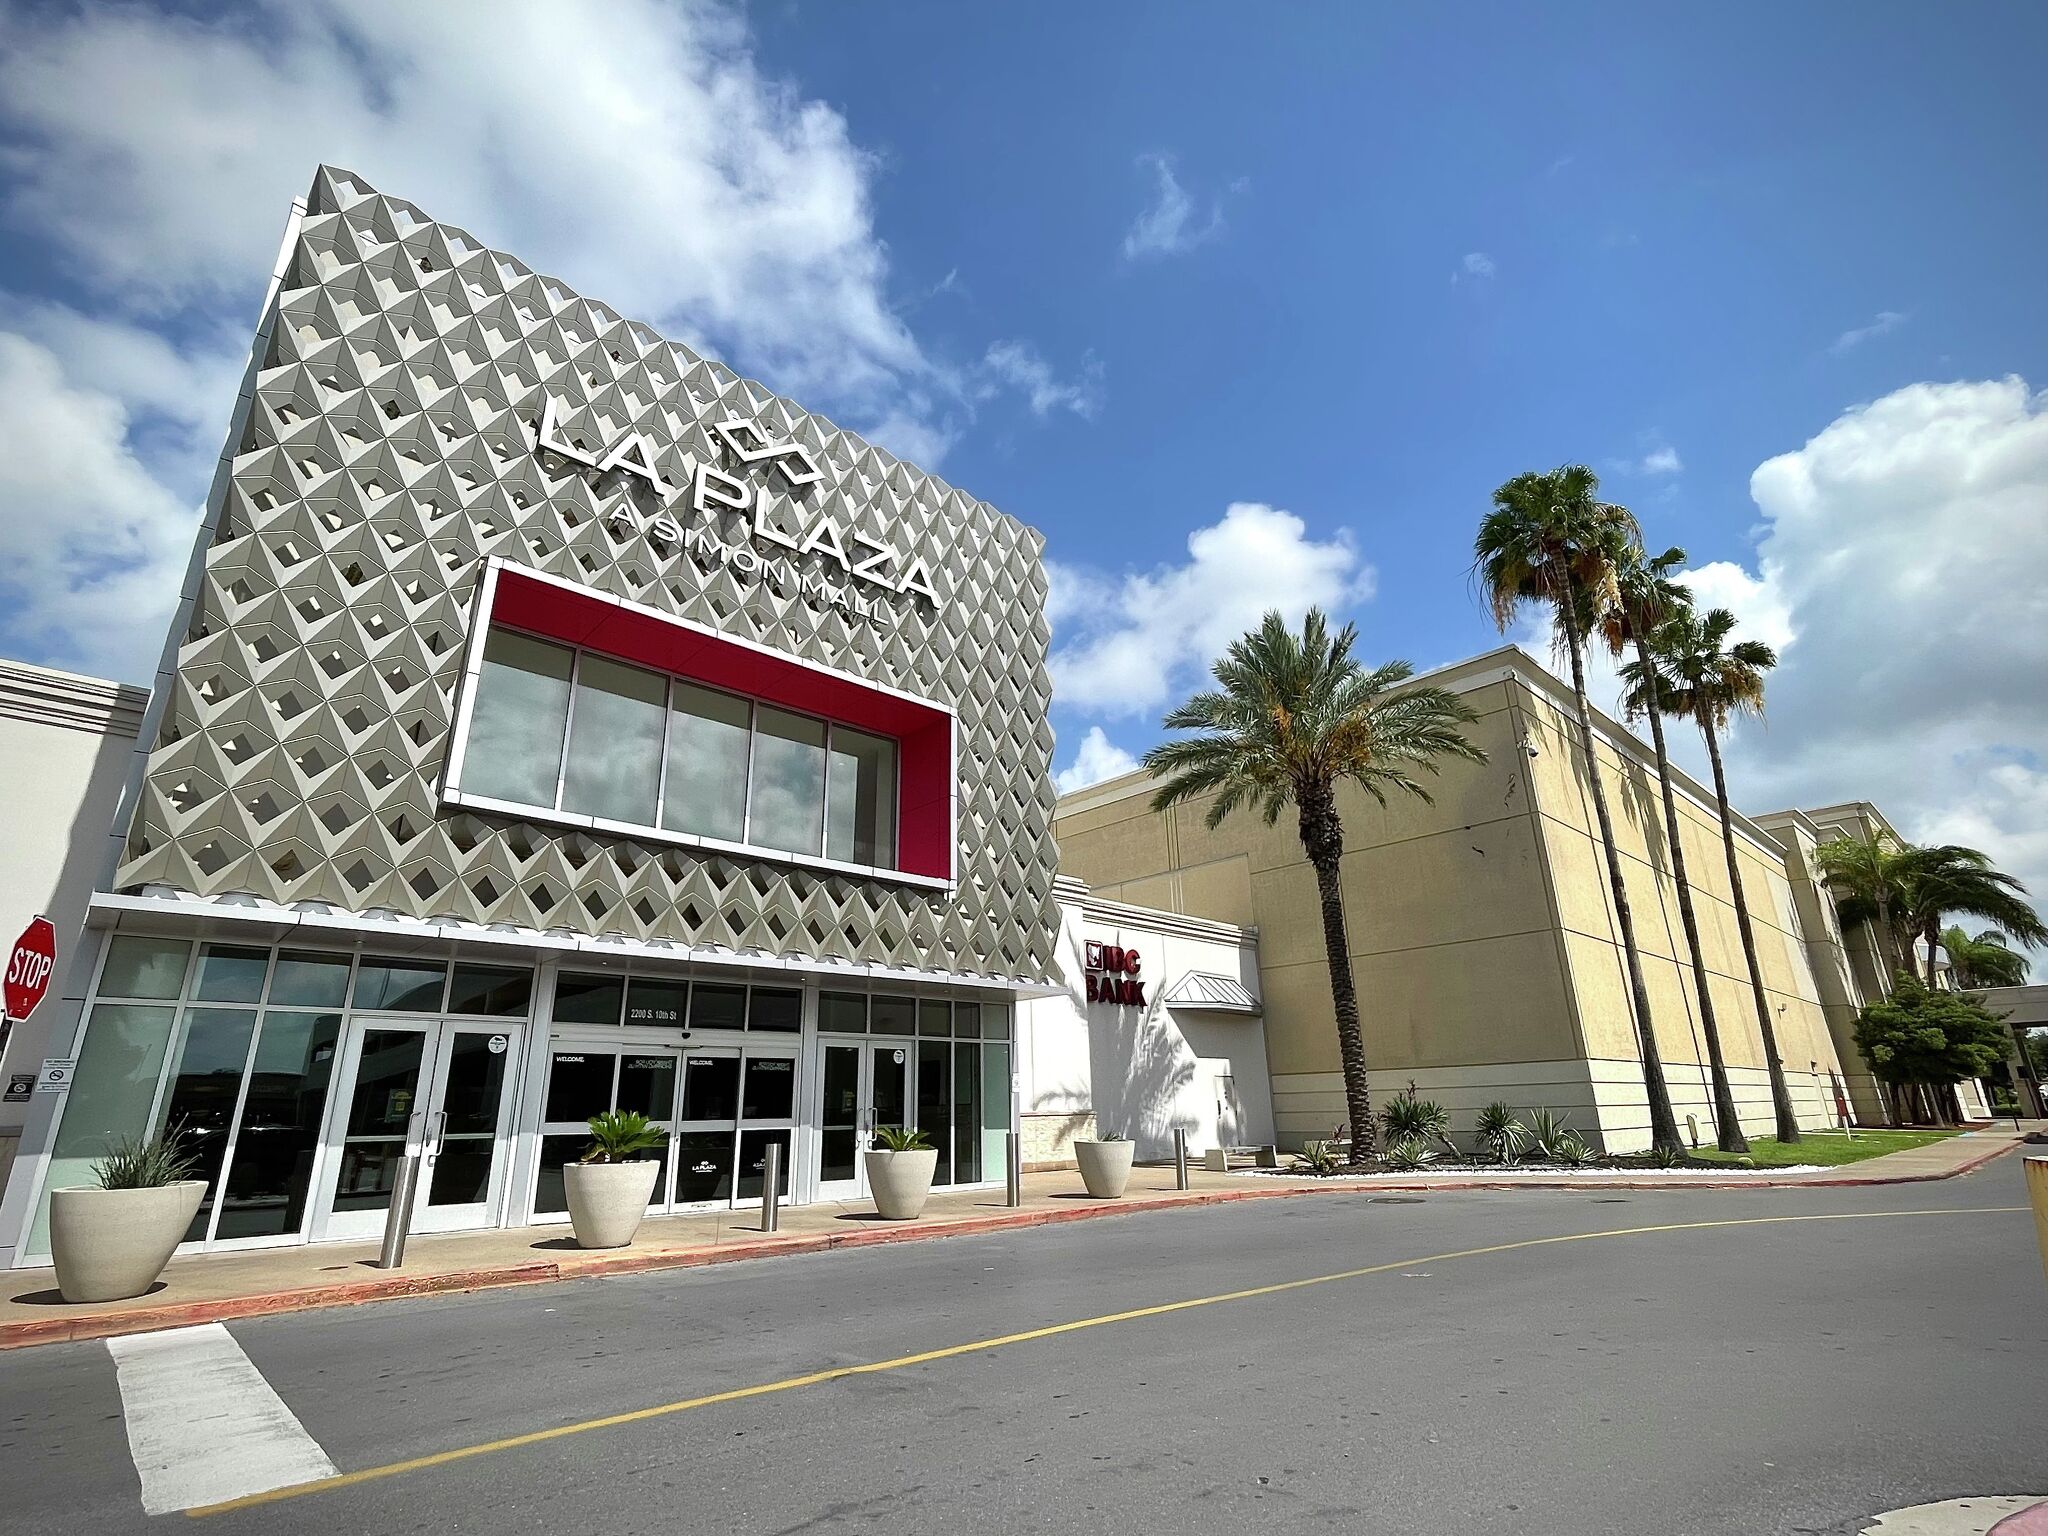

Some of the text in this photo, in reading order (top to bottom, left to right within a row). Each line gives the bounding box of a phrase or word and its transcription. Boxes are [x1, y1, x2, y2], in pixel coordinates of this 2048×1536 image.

[538, 396, 941, 609] LA PLAZA
[608, 503, 890, 625] A SIMON MALL
[9, 947, 51, 989] STOP
[1085, 974, 1147, 1006] BANK
[631, 1009, 646, 1019] 2200
[655, 1010, 668, 1020] 10th
[669, 1010, 677, 1020] St
